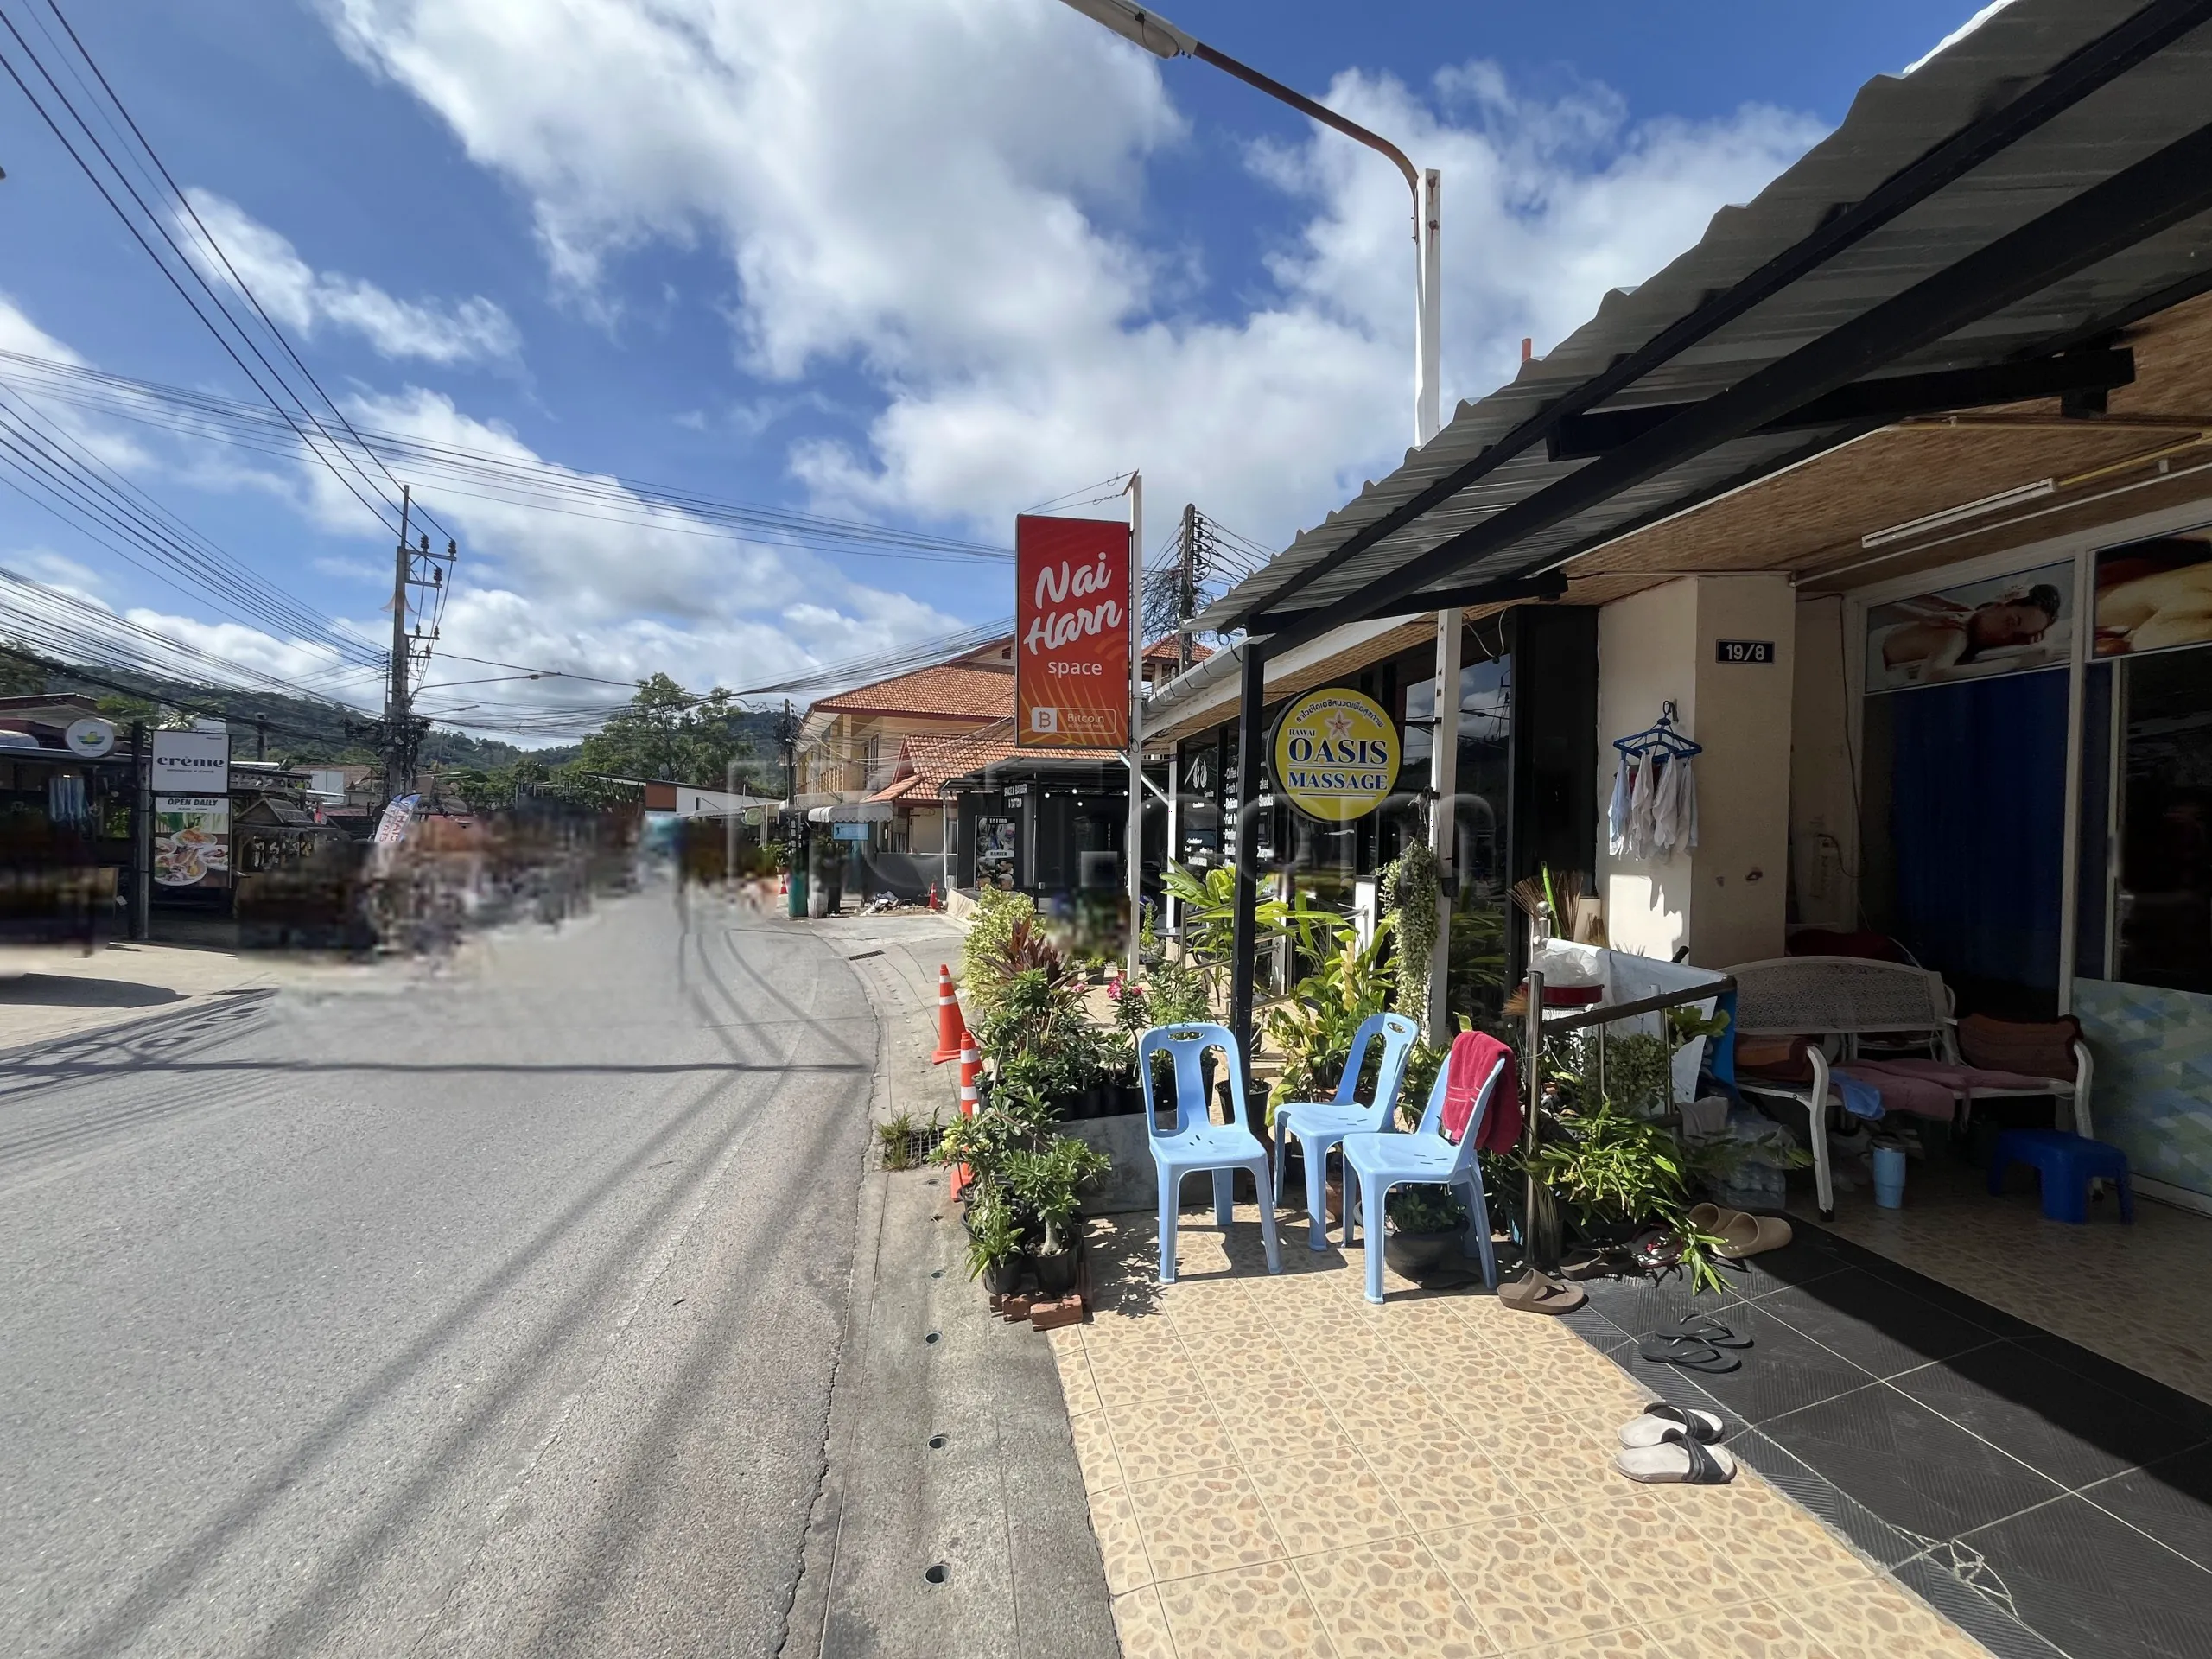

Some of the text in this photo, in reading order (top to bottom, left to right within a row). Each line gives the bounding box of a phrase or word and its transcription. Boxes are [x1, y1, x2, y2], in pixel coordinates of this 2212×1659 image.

[1034, 551, 1112, 609] Nai
[1023, 599, 1122, 655] Harn
[1726, 644, 1765, 661] 19/8
[1047, 661, 1103, 678] space
[1067, 713, 1105, 723] Bitcoin
[1289, 728, 1316, 737] RAWAI
[1288, 738, 1388, 765] OASIS
[1288, 772, 1388, 791] MASSAGE
[1258, 793, 1274, 808] Snacks
